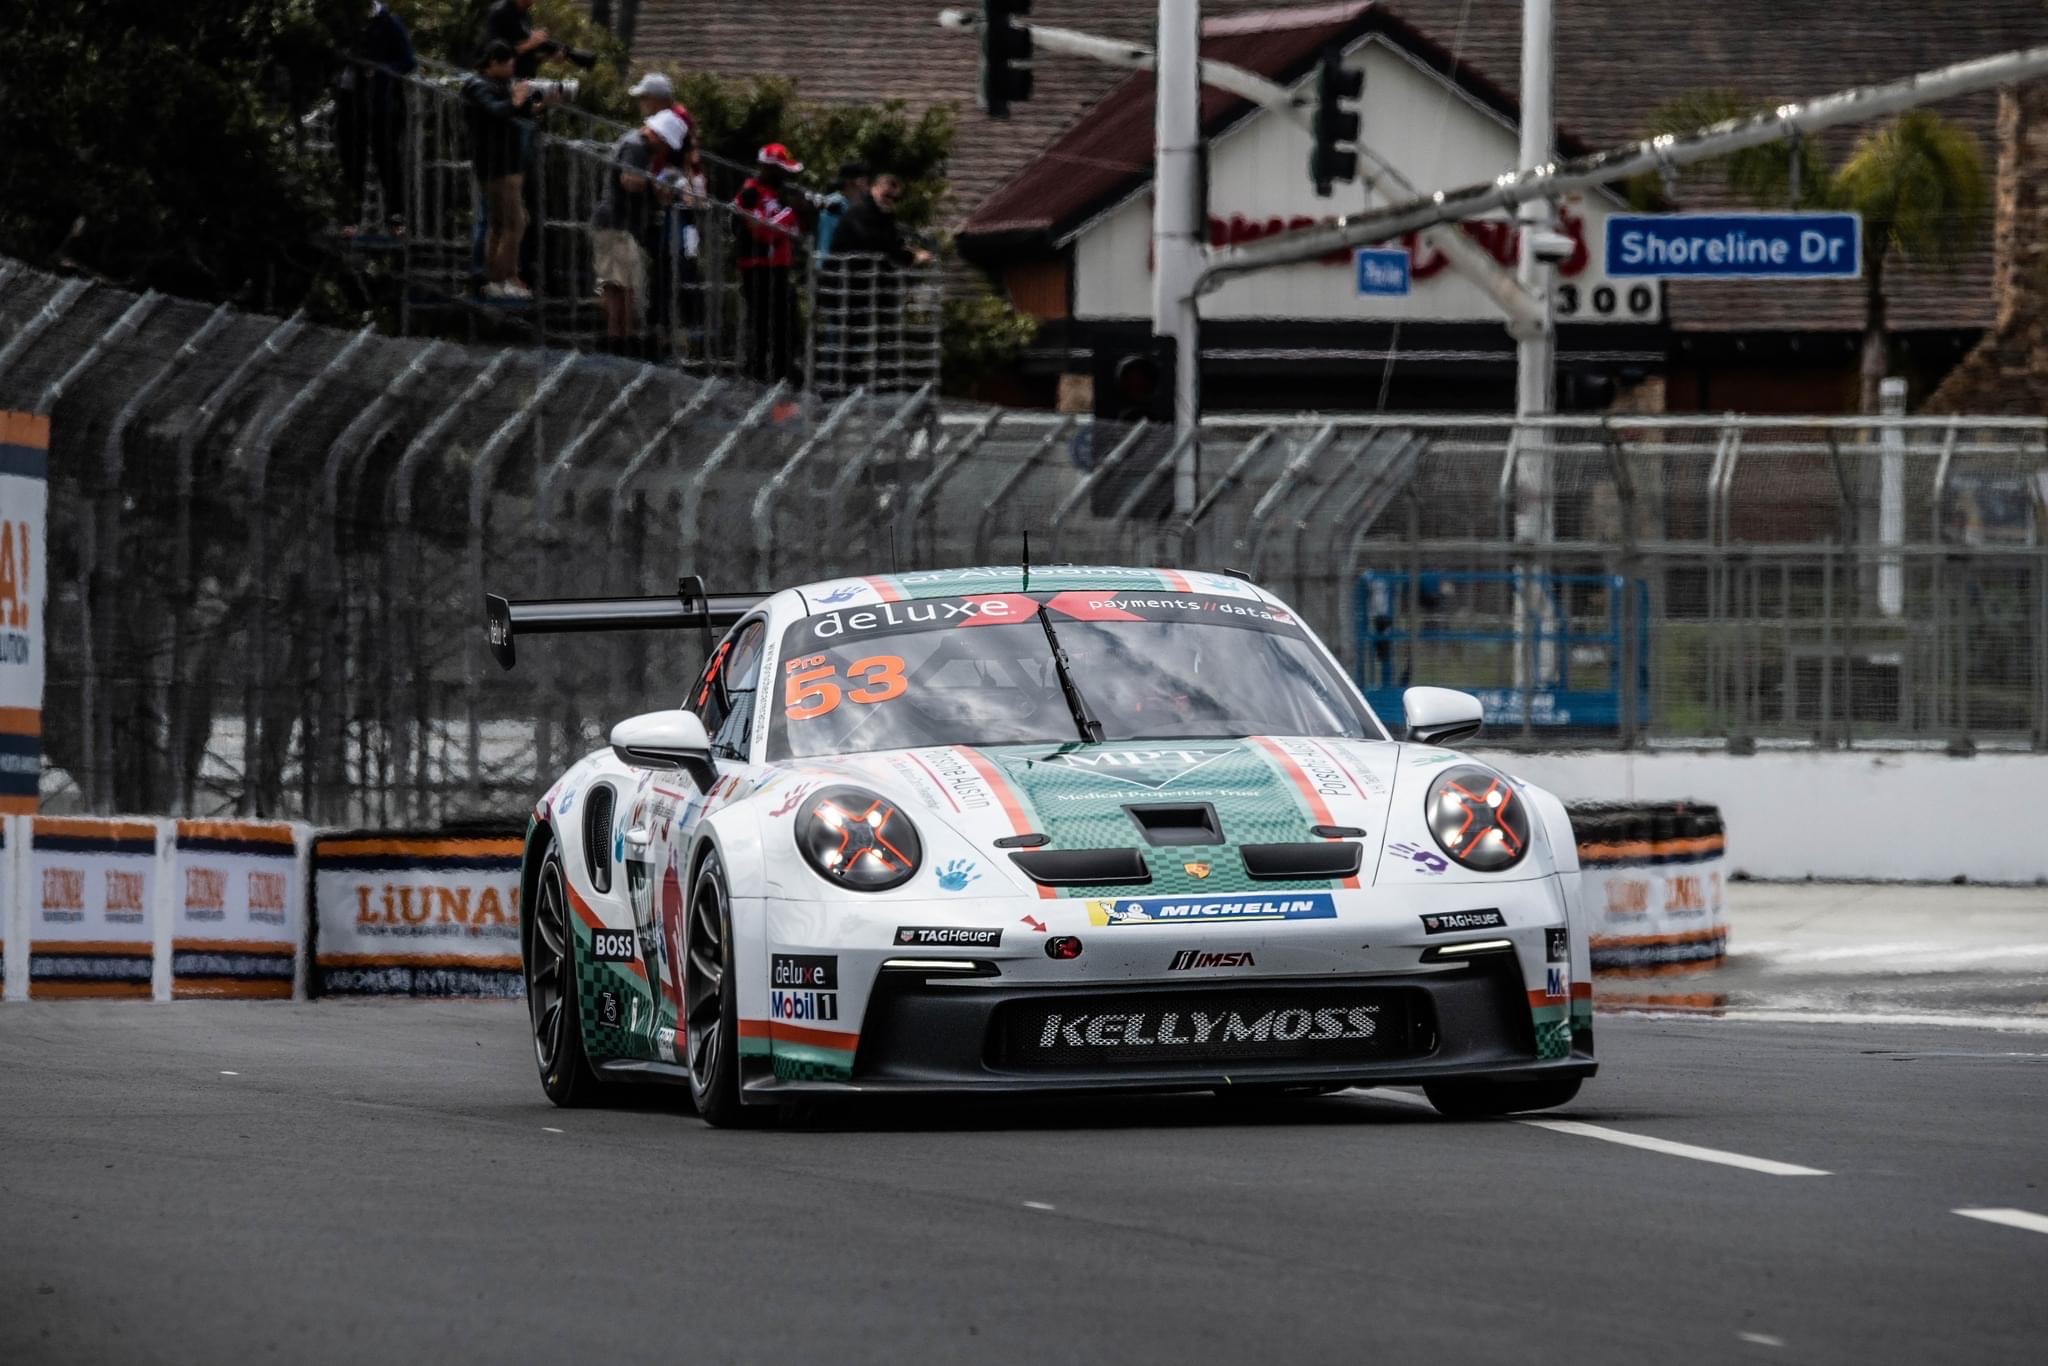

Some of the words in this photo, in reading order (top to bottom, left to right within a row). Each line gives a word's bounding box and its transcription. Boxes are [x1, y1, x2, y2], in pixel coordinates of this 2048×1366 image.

[1621, 230, 1790, 264] Shoreline
[1800, 231, 1846, 263] Dr
[814, 600, 1009, 638] deluxe
[785, 655, 826, 674] Pro
[785, 656, 908, 721] 53
[1062, 750, 1206, 767] MPT
[1058, 791, 1124, 802] Medical
[1128, 789, 1213, 800] Properties
[1214, 789, 1261, 798] Trust
[355, 882, 520, 926] LiUNA!
[1159, 900, 1314, 917] MICHELIN
[595, 934, 632, 957] BOSS
[775, 959, 825, 984] deluxe
[1194, 951, 1256, 969] IMSA
[771, 991, 815, 1020] Mobil
[1039, 1006, 1381, 1048] KELLYMOSS
